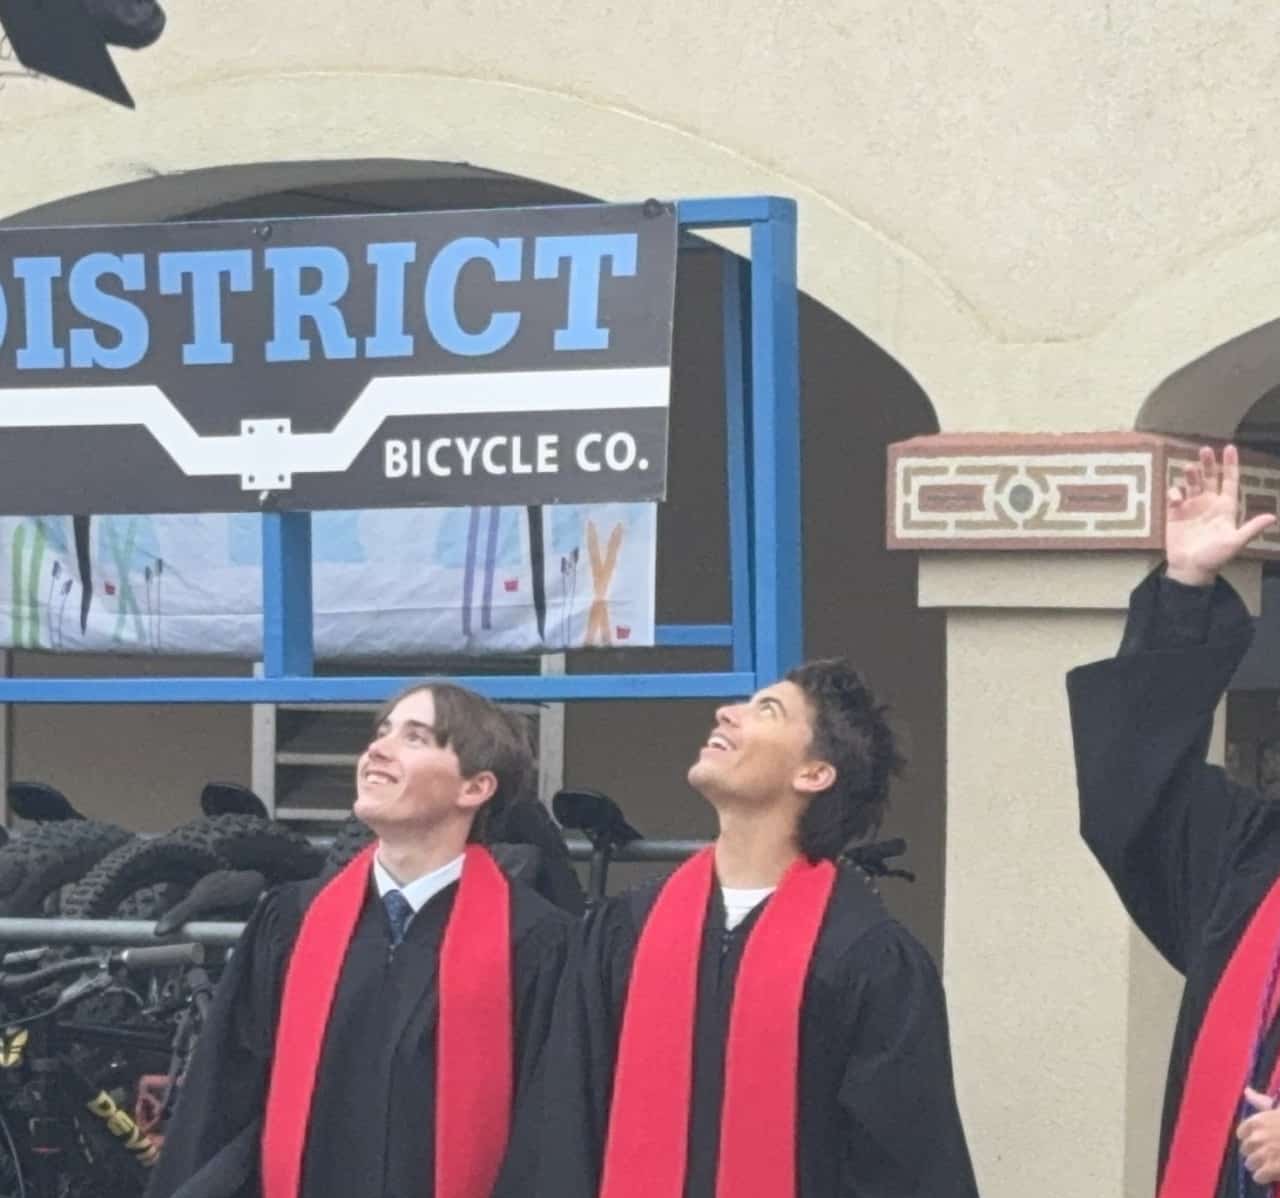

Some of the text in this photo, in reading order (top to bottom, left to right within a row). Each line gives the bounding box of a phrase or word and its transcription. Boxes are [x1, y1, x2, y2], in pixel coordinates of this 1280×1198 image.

[0, 233, 638, 371] ISTRICT
[384, 431, 649, 479] BICYCLE CO.
